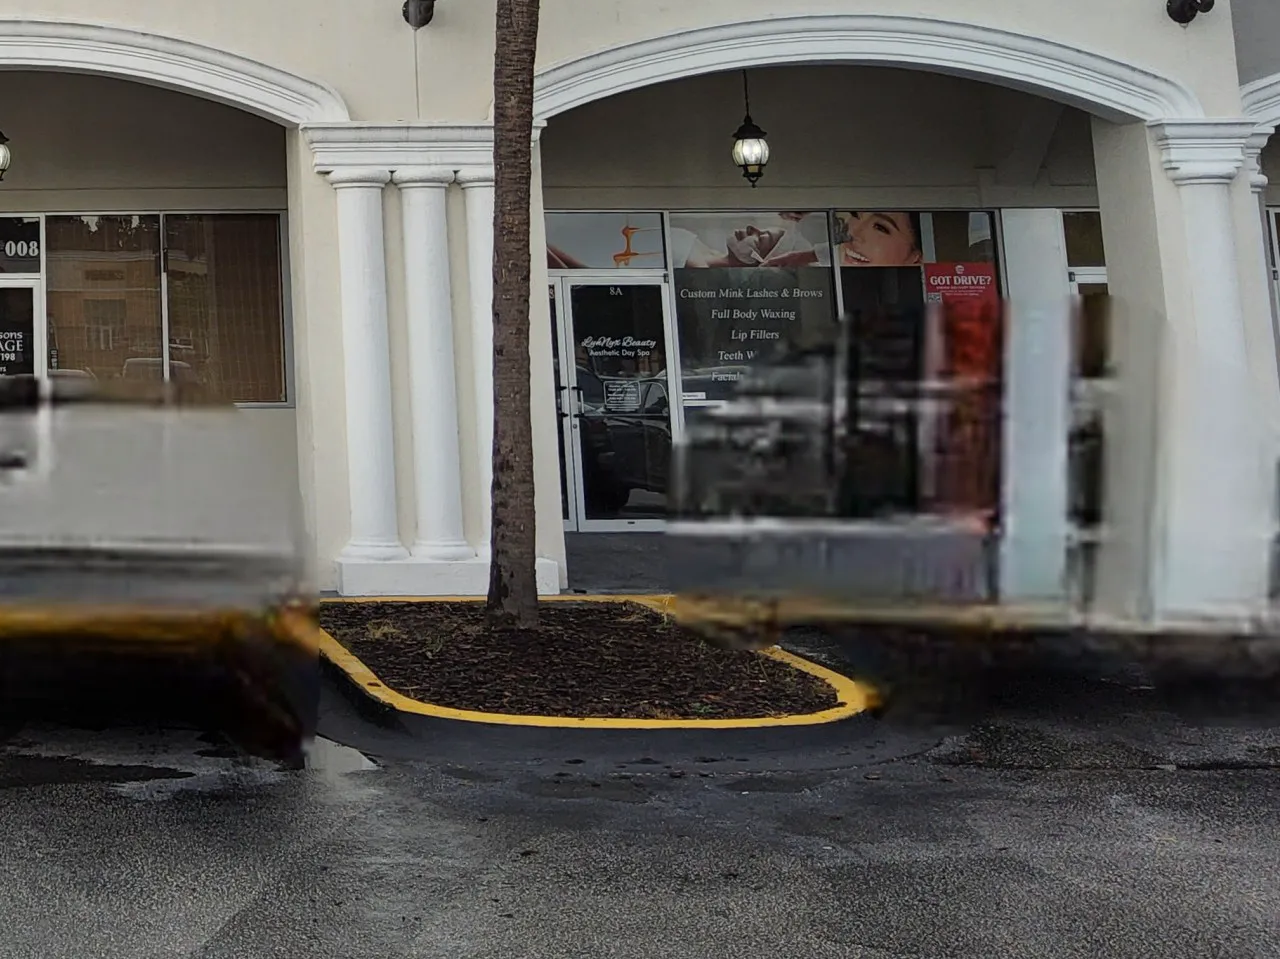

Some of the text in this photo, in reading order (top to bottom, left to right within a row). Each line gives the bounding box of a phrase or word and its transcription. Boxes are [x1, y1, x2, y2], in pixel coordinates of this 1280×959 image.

[930, 276, 991, 285] GOT DRIVE?
[609, 287, 623, 296] 8A
[680, 288, 823, 298] Custom Mink Lashes & Brows
[711, 309, 796, 320] Full Body Waxing
[731, 330, 780, 341] Lip Fillers
[622, 336, 656, 347] Beauty
[622, 349, 635, 357] Day
[637, 349, 650, 357] Spa
[718, 351, 743, 360] Teeth
